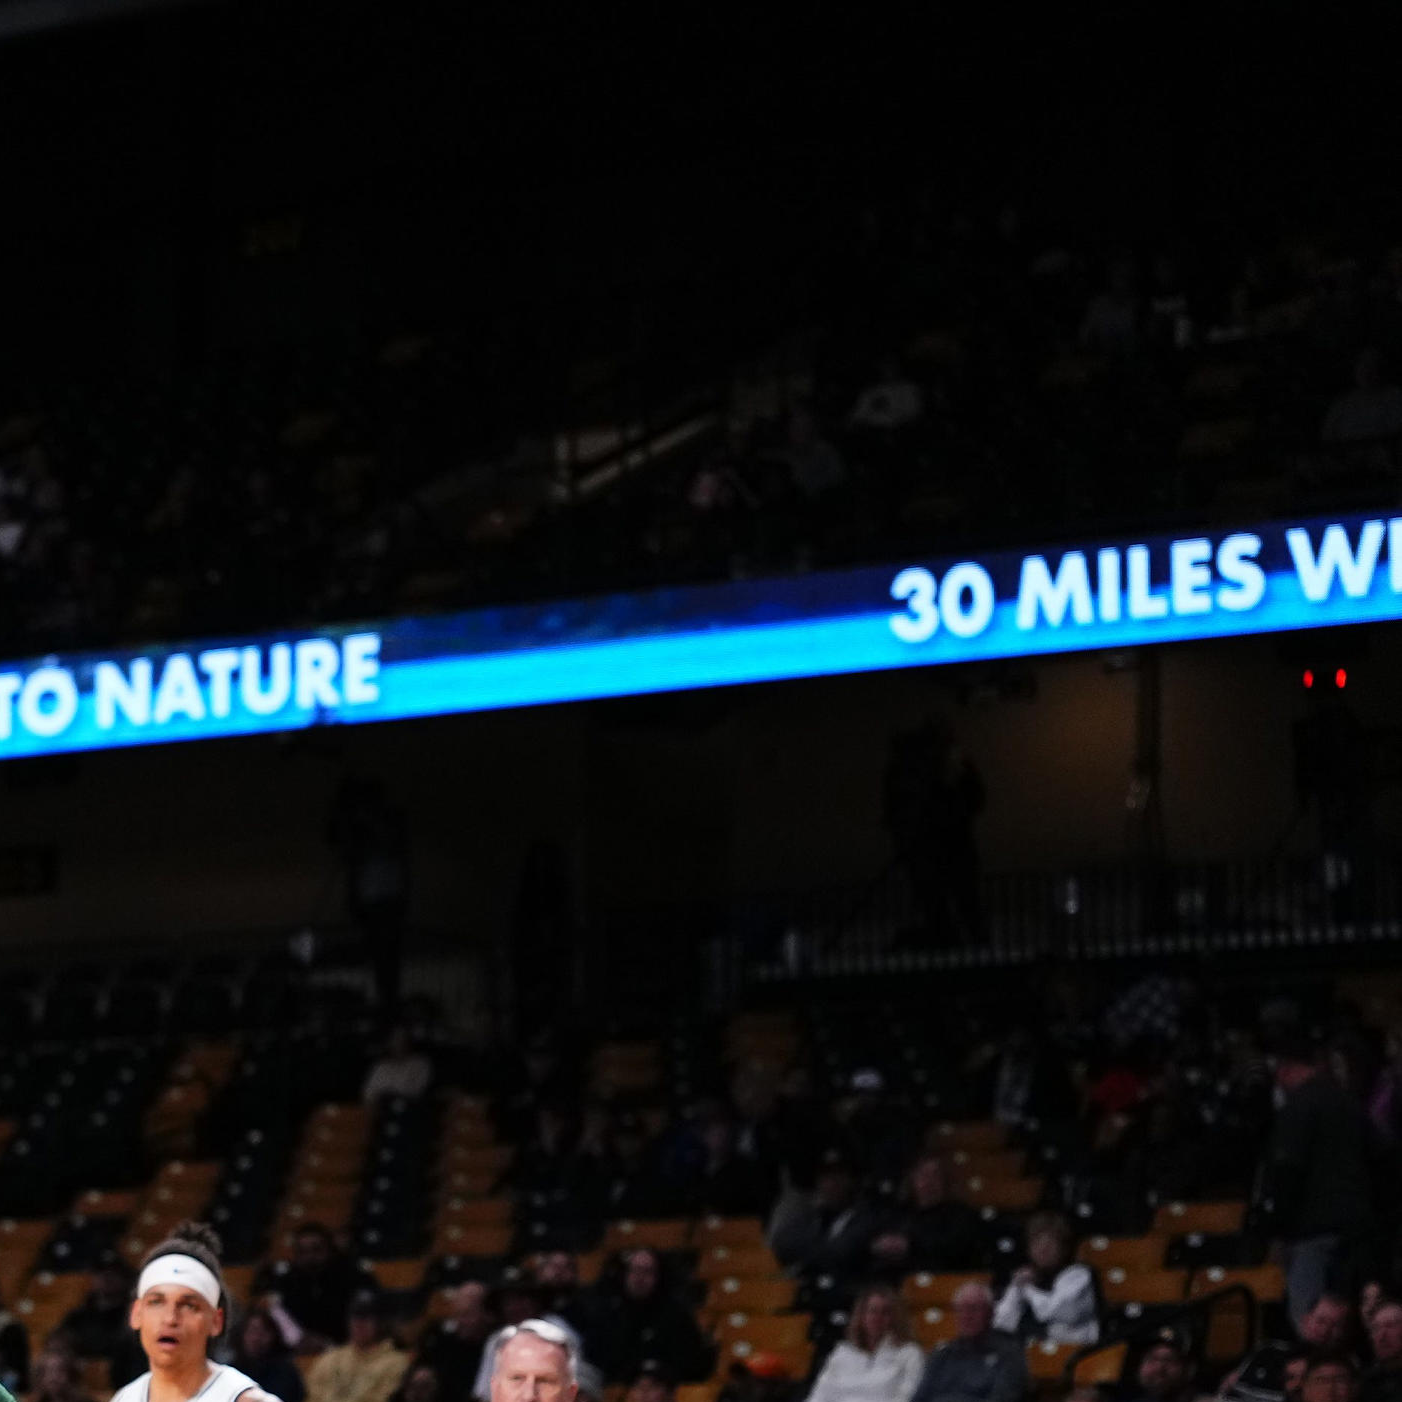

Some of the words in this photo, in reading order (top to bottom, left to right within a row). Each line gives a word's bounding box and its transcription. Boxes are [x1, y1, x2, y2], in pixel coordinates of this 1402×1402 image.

[890, 562, 994, 642] 30
[1016, 533, 1270, 630] MILES
[94, 632, 383, 730] NATURE
